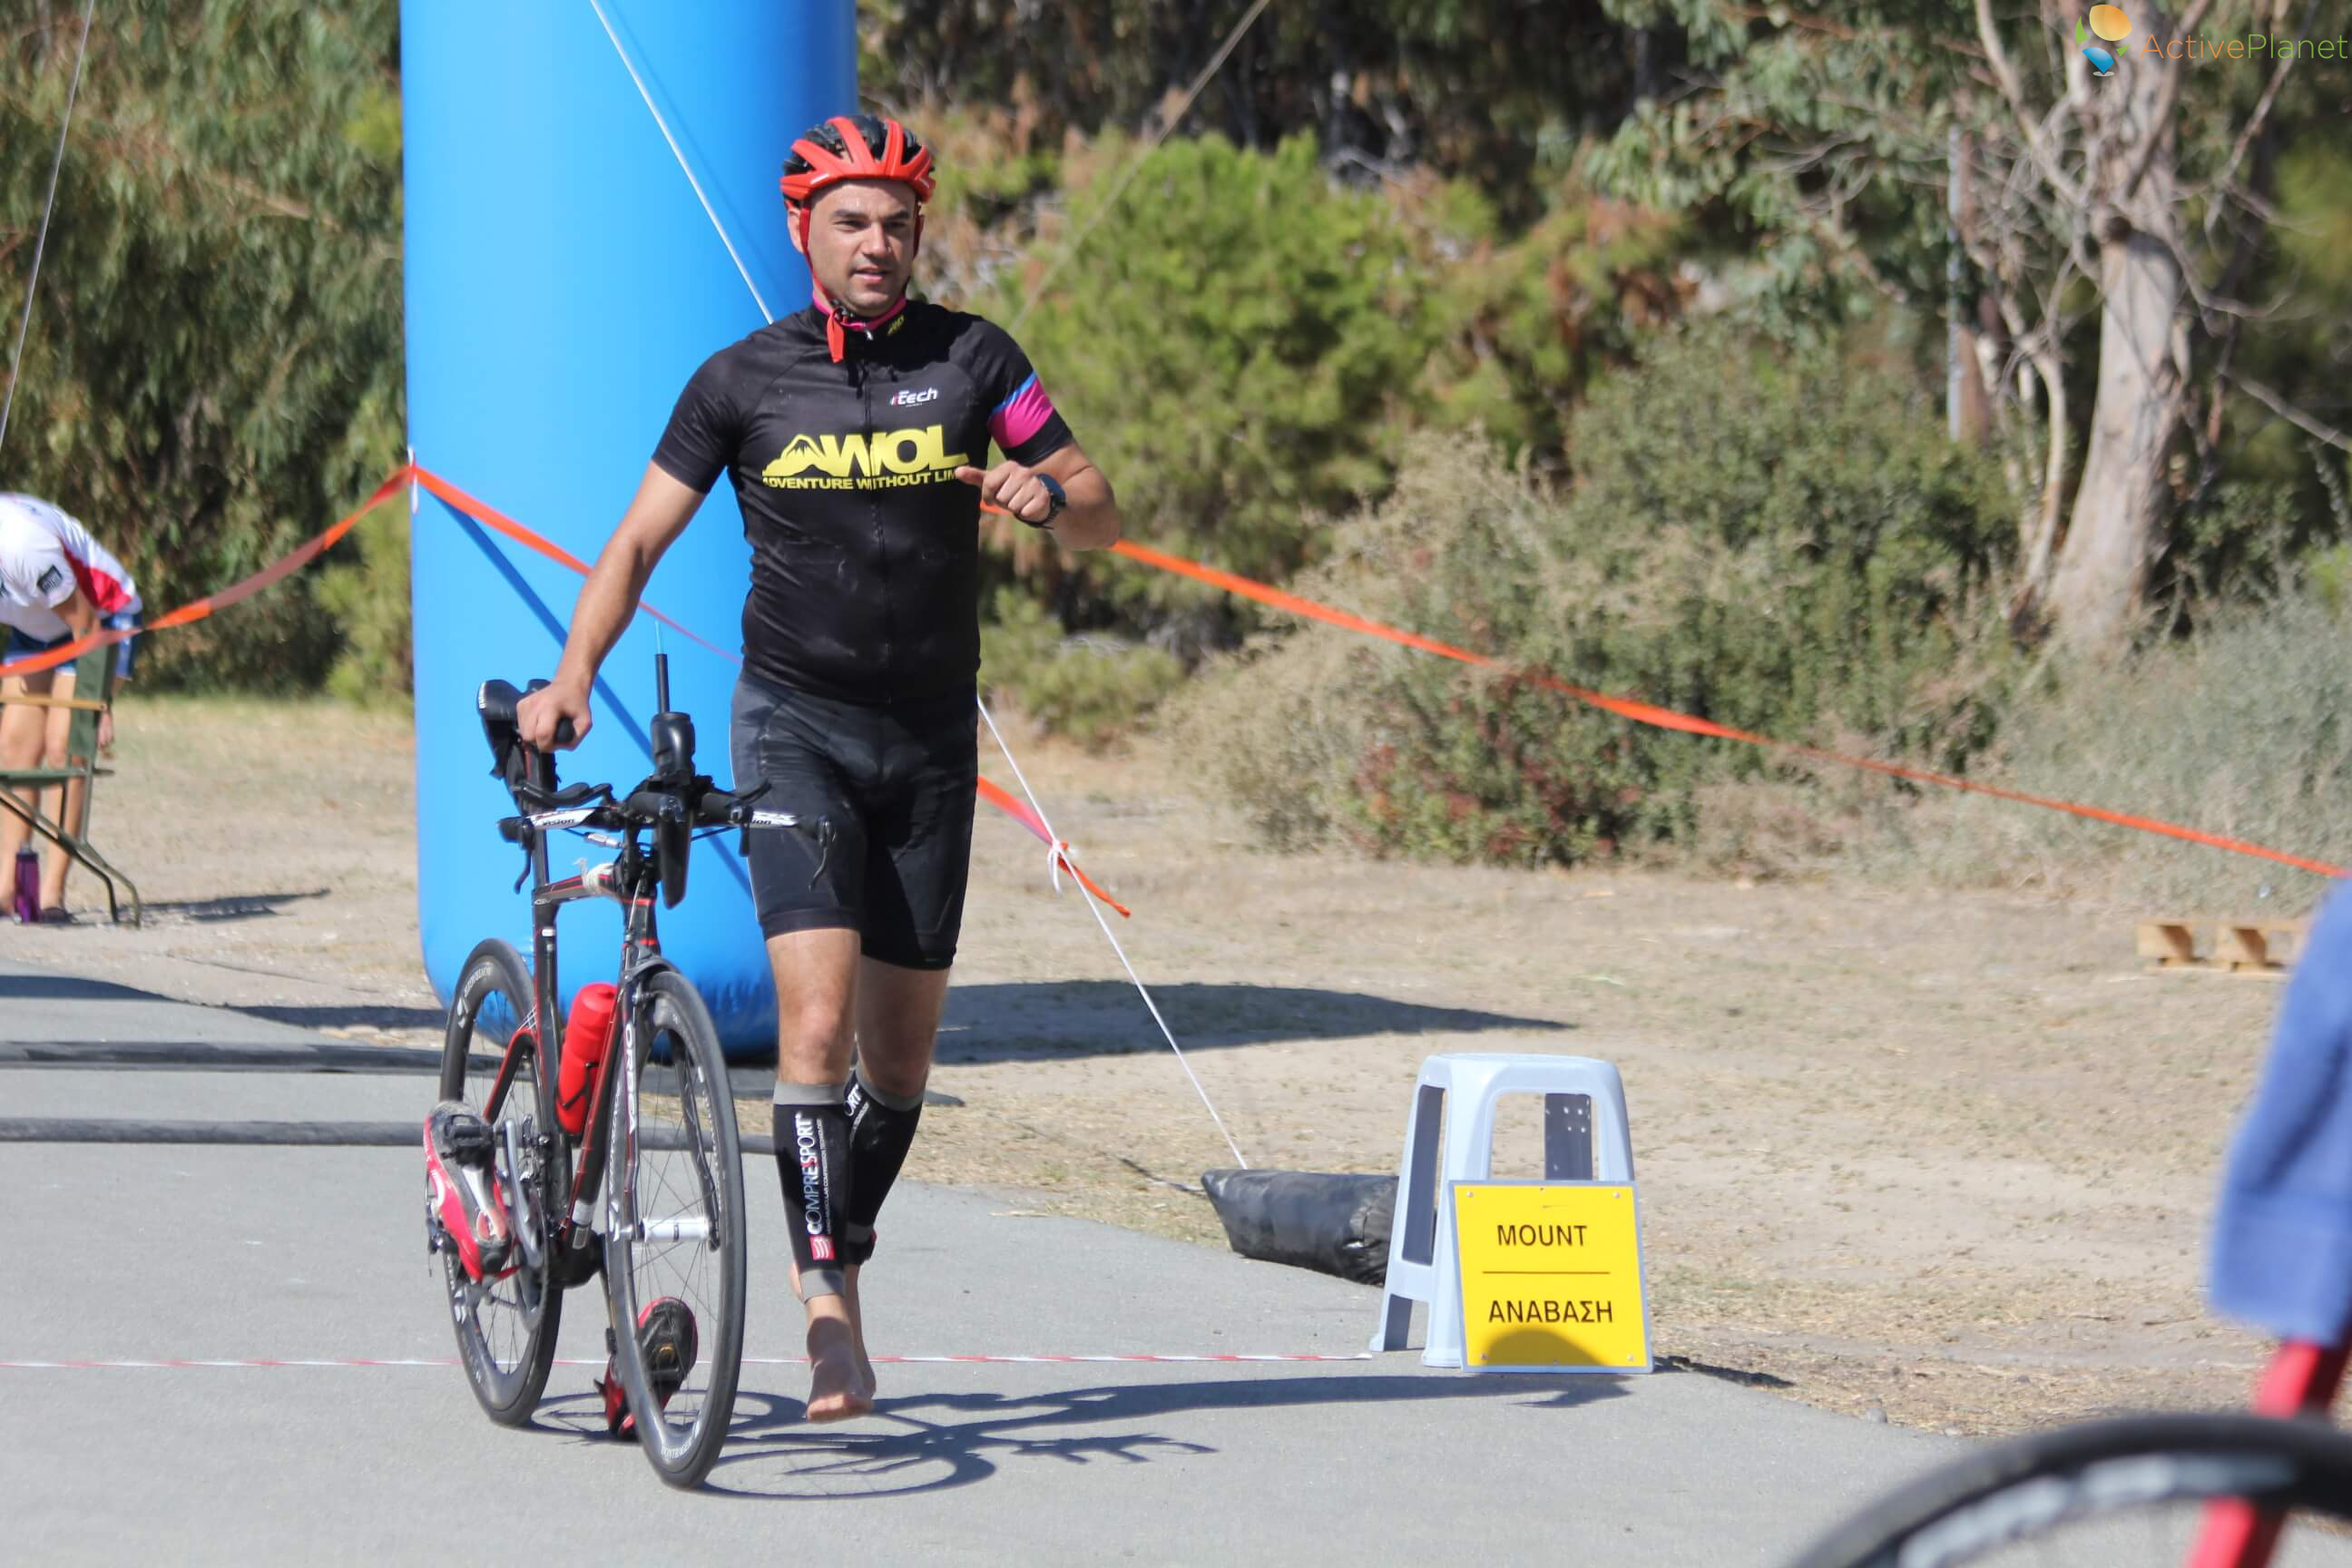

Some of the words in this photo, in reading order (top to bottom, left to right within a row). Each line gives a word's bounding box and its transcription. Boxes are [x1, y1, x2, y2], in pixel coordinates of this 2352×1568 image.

[762, 477, 854, 490] ADVENTURE
[856, 472, 932, 491] WITHOUT
[934, 468, 958, 484] LIM
[624, 1020, 637, 1135] ORBEA
[1496, 1225, 1587, 1247] MOUNT
[1488, 1300, 1613, 1323] ΑΝΑΒΑΣΗ
